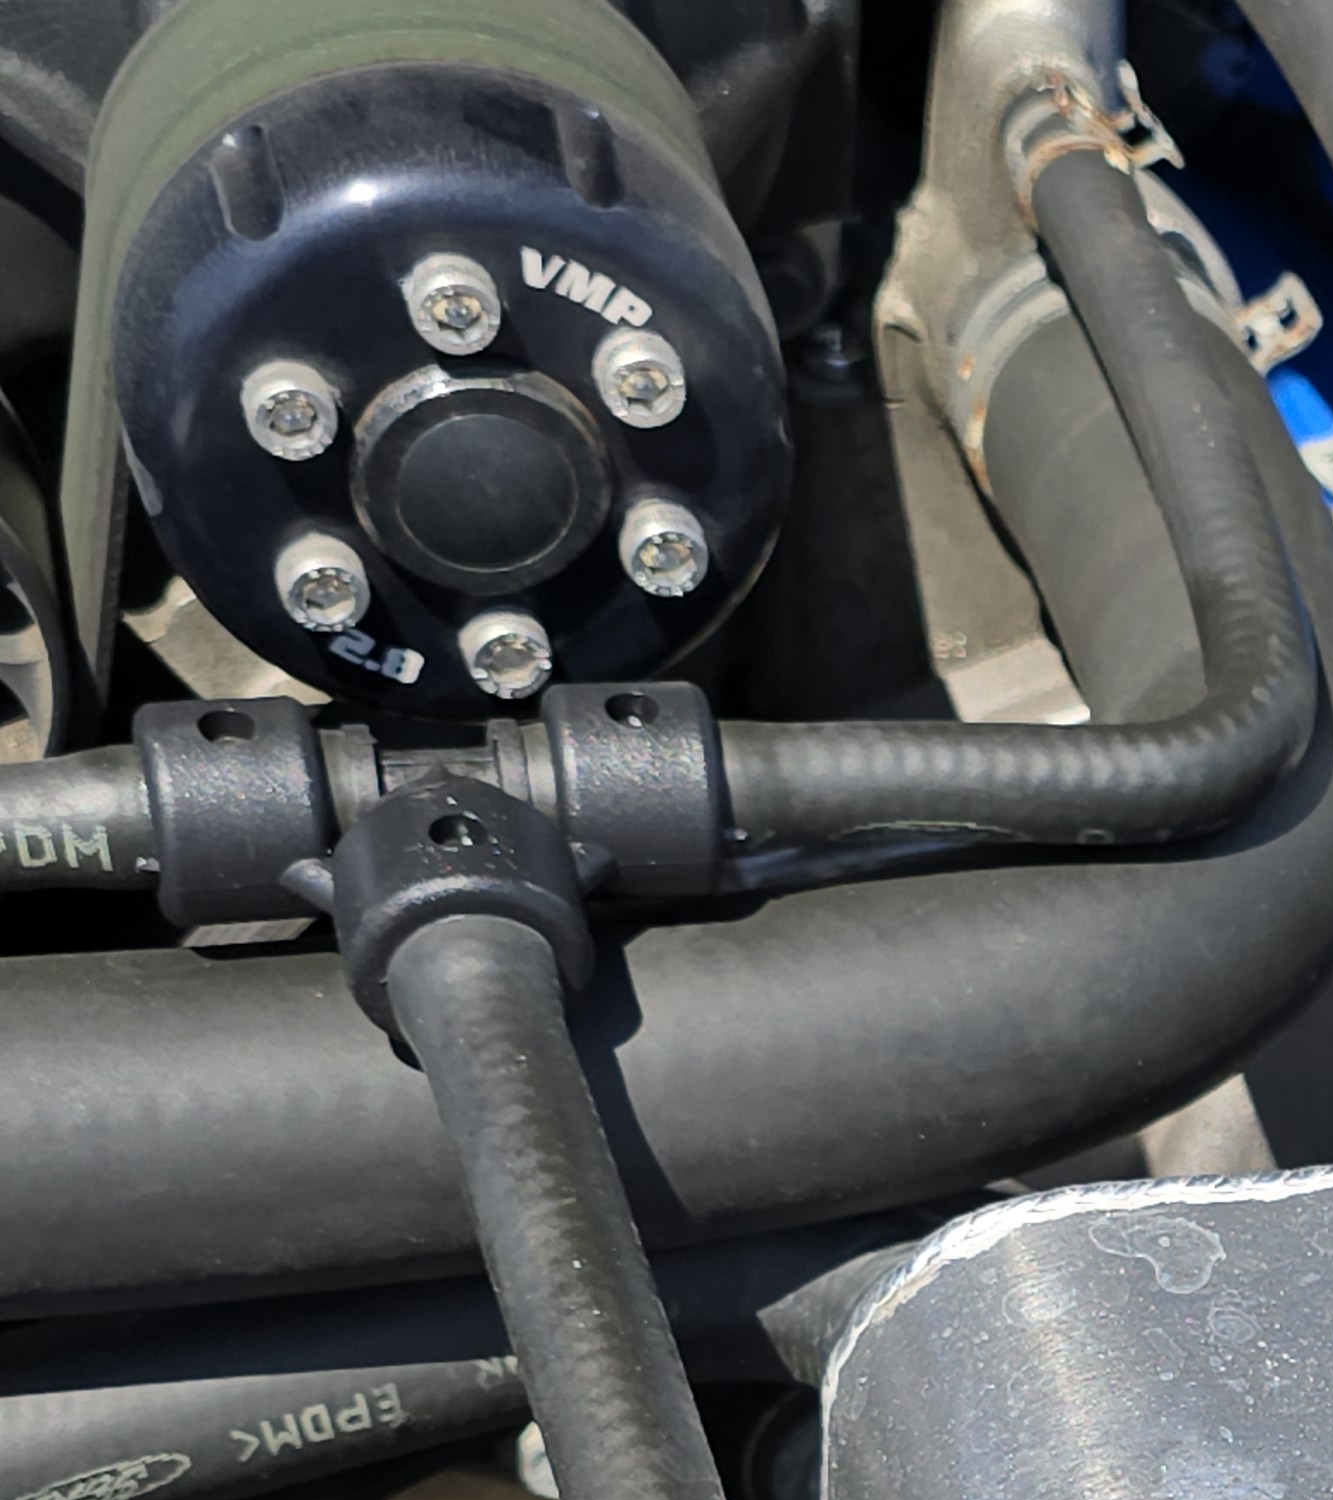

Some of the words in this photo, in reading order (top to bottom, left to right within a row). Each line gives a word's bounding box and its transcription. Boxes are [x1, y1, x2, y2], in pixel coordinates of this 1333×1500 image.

[520, 245, 653, 327] VMP
[330, 628, 425, 684] 2.8
[0, 820, 114, 872] DM
